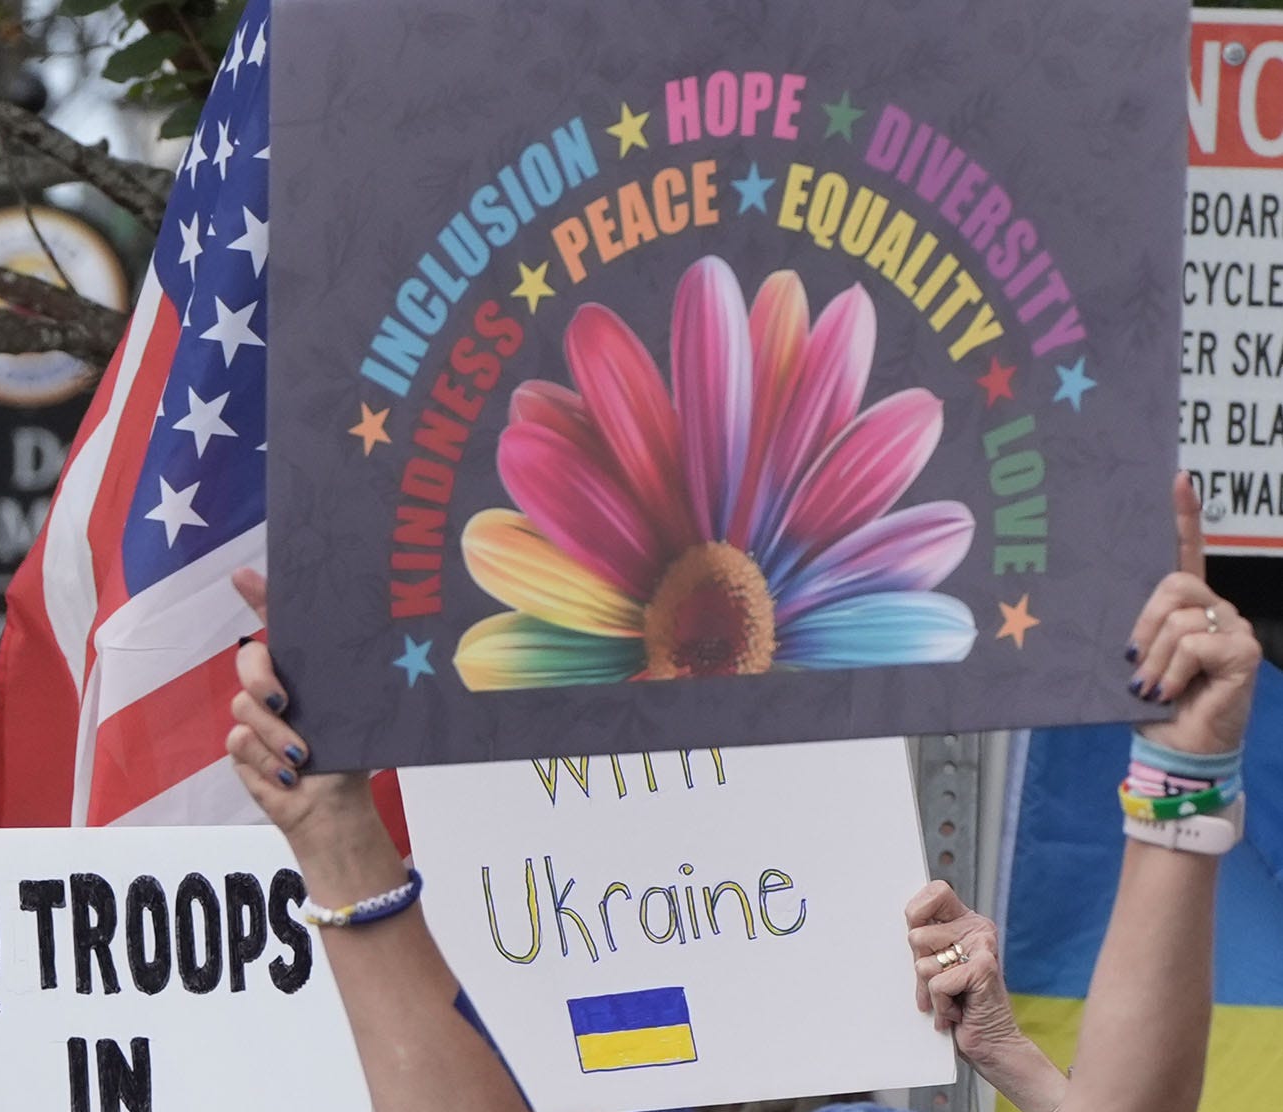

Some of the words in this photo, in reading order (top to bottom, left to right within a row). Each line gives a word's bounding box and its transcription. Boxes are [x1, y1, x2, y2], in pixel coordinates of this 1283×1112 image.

[665, 70, 807, 145] HOPE
[359, 117, 600, 398] INCLUSION
[551, 159, 720, 285] PEACE
[778, 162, 1005, 363] EQUALITY
[865, 104, 1087, 358] DIVERSITY
[1184, 191, 1283, 238] BOAR
[390, 299, 525, 619] KINDNESS
[982, 413, 1049, 577] LOVE
[18, 867, 314, 996] TROOPS
[481, 855, 808, 965] Ukraine
